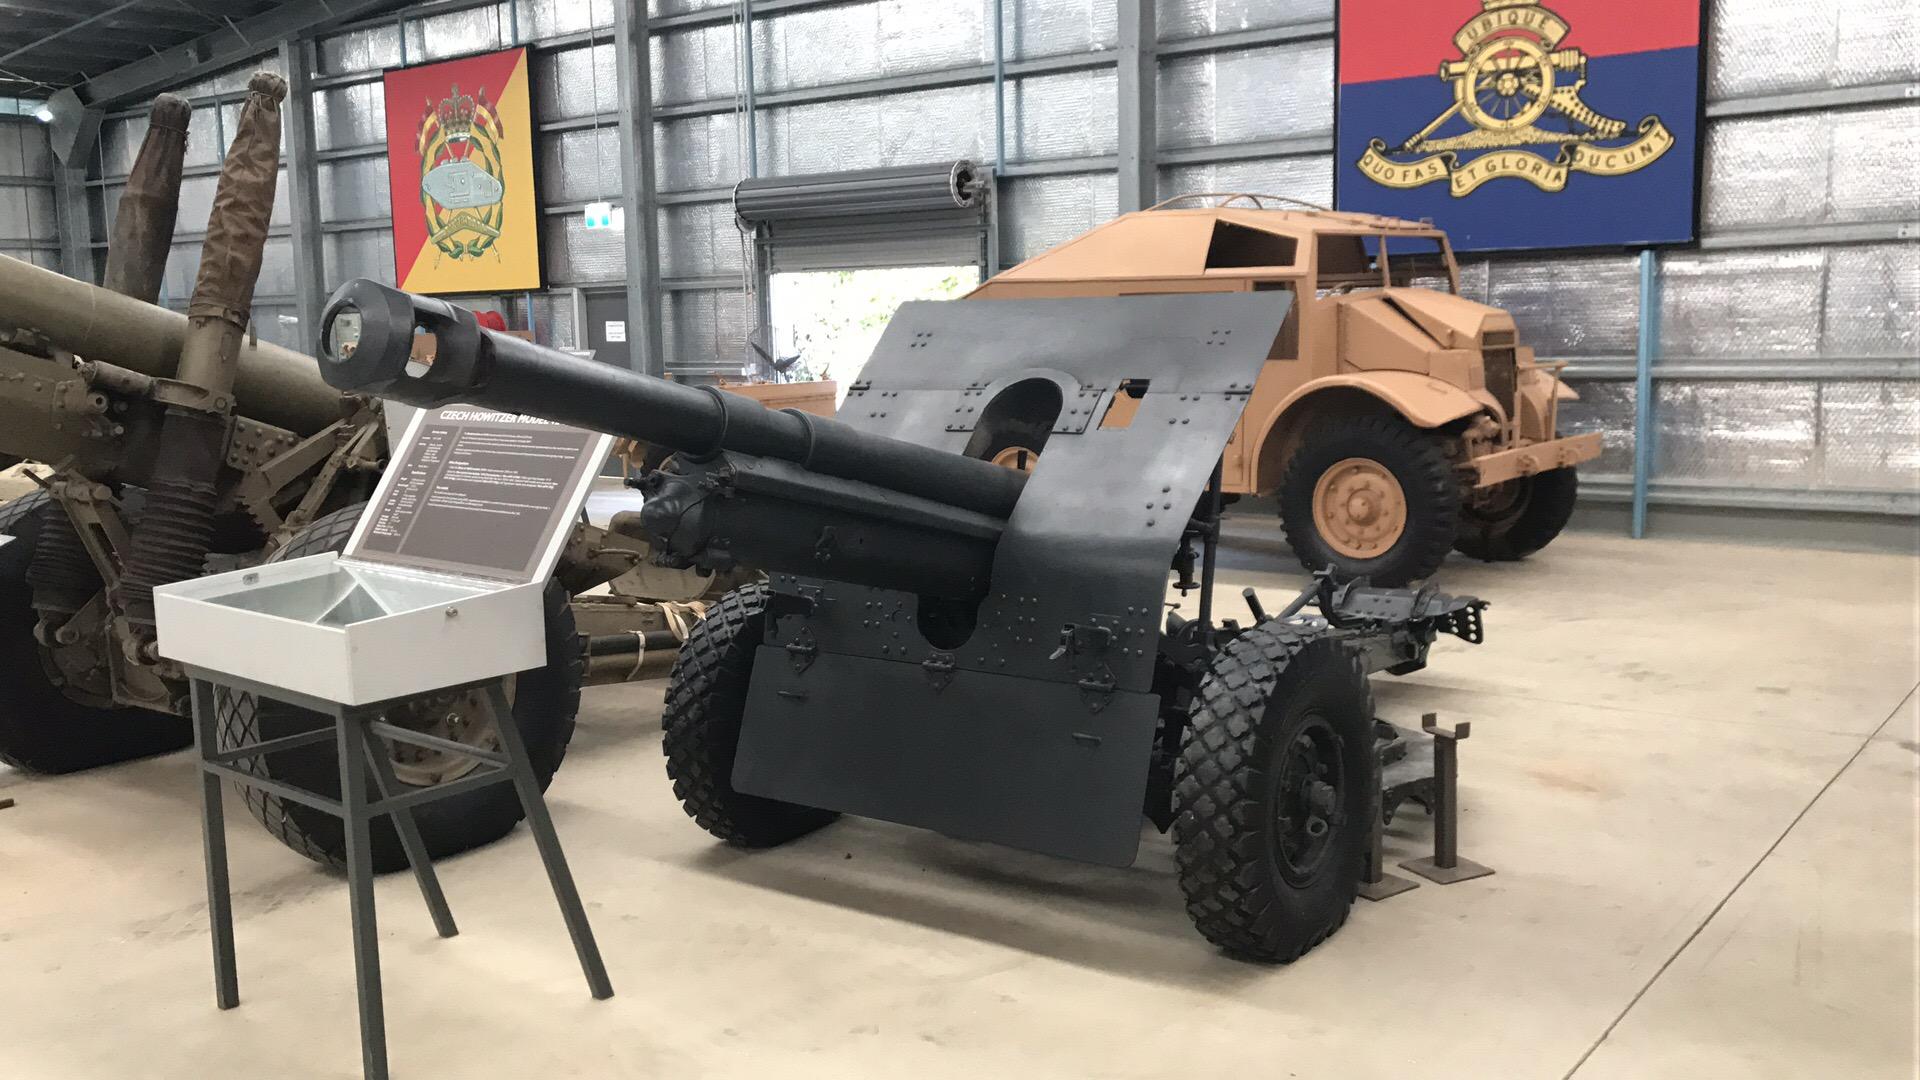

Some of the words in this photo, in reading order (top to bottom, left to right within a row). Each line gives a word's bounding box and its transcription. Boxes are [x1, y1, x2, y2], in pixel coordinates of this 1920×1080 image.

[1467, 10, 1548, 40] UBIQUE
[1363, 155, 1395, 180] QUO
[1402, 163, 1438, 182] FAS
[1456, 168, 1477, 189] ET
[1486, 155, 1564, 184] GLORIA
[1575, 131, 1666, 168] DUCUNT
[440, 410, 470, 421] CZECH
[470, 411, 518, 423] HOWITZER
